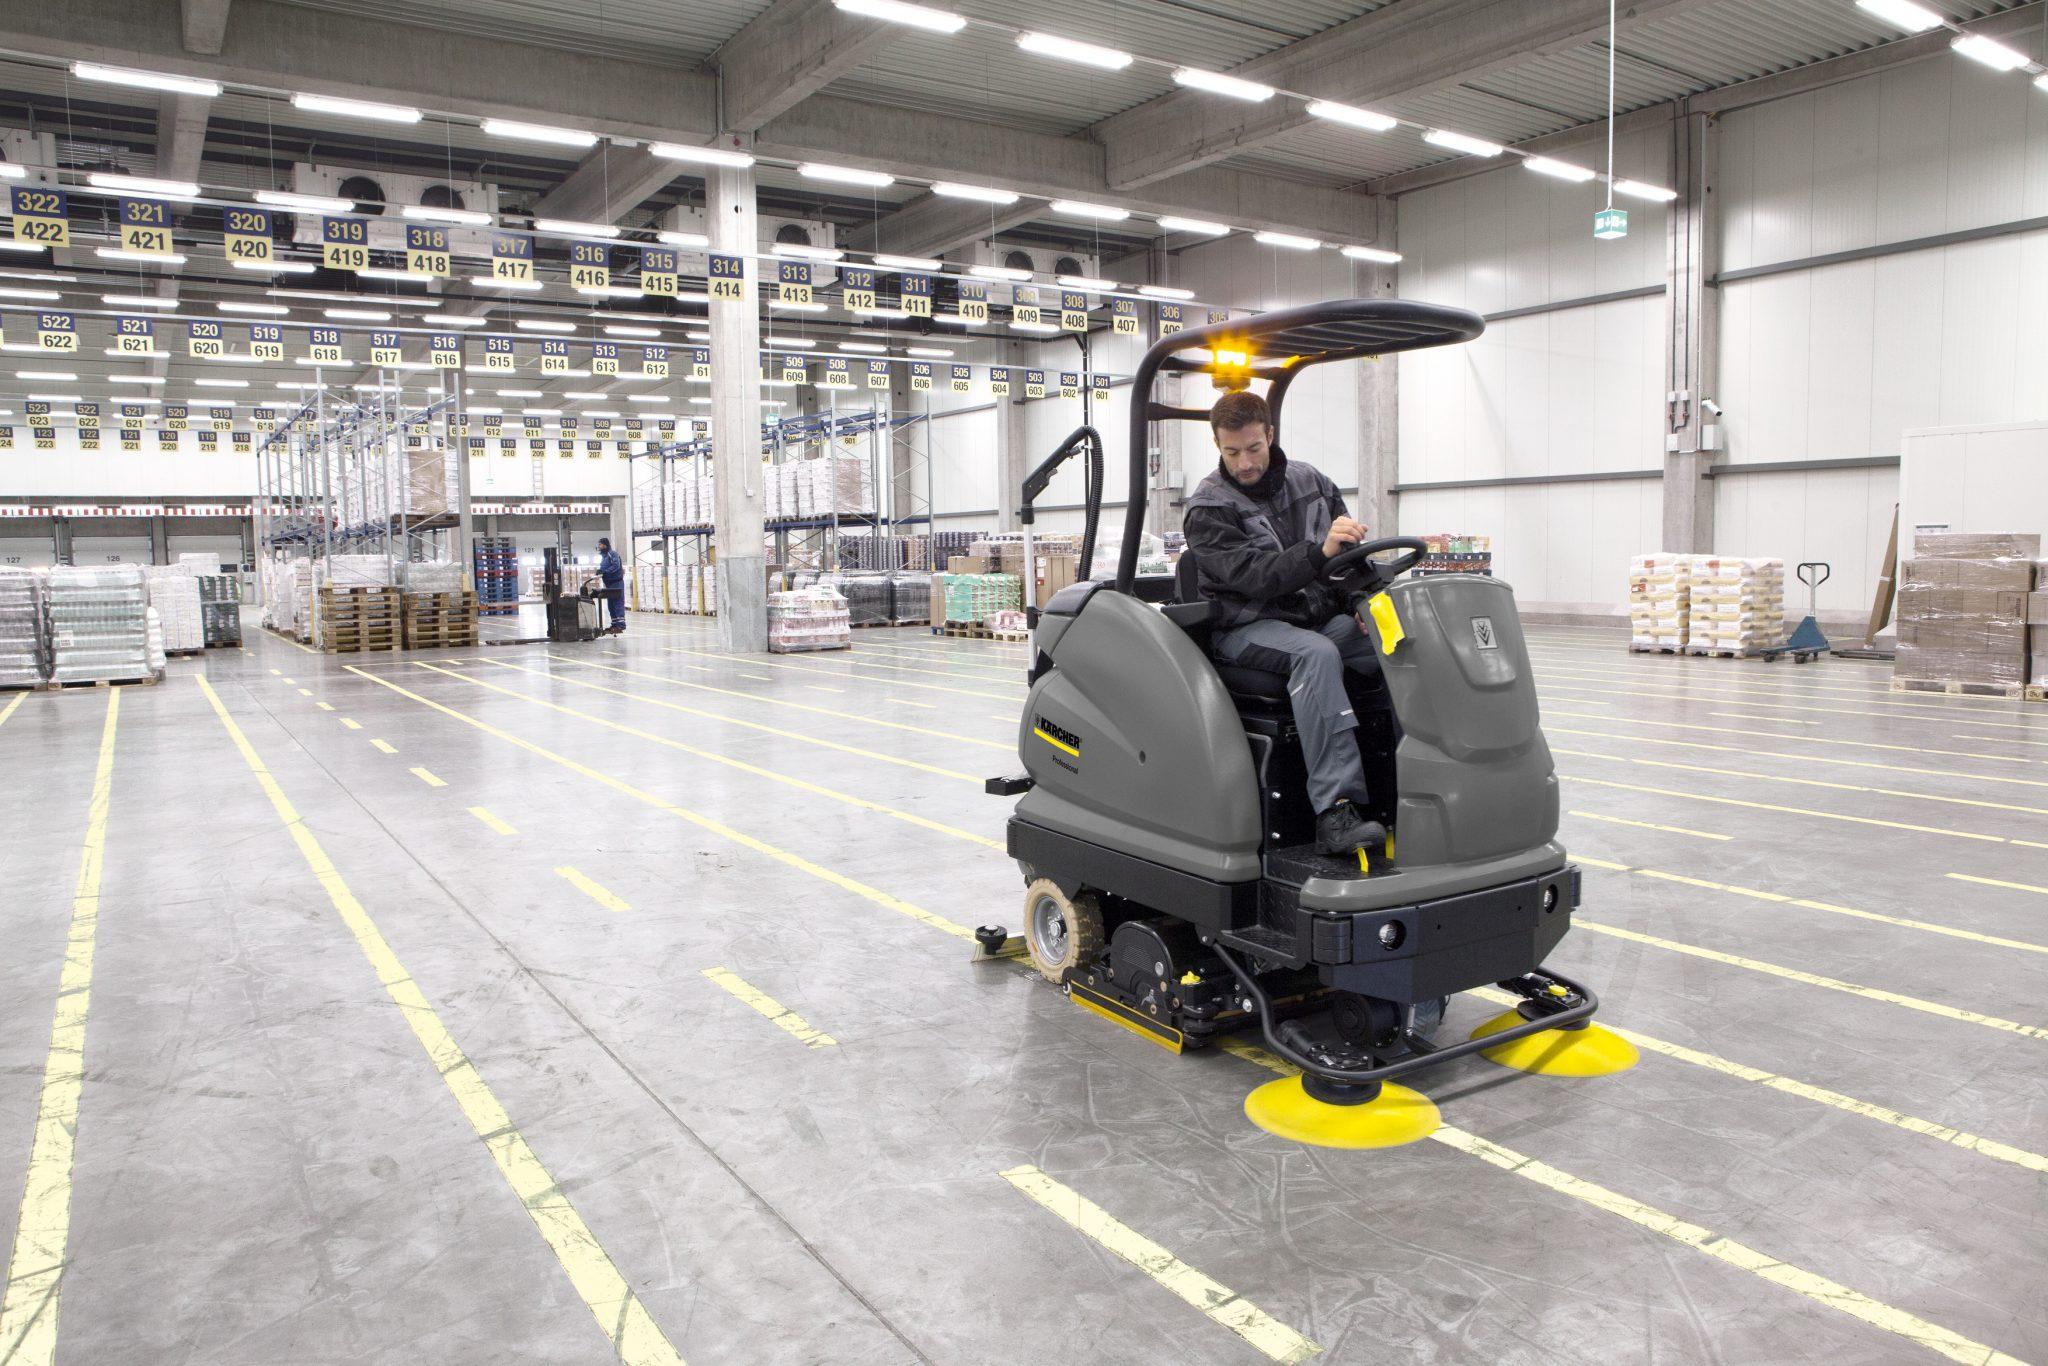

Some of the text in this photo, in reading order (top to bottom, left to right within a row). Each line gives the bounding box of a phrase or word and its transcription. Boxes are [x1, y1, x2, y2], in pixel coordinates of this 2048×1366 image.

[18, 191, 61, 214] 322
[127, 202, 164, 223] 321
[229, 212, 266, 232] 320
[21, 221, 64, 242] 422
[327, 221, 363, 241] 319
[128, 231, 165, 250] 421
[411, 229, 444, 248] 318
[231, 239, 268, 258] 420
[575, 246, 605, 263] 316
[330, 248, 364, 266] 419
[645, 252, 674, 269] 315
[414, 255, 446, 273] 418
[497, 262, 528, 278] 417
[713, 258, 740, 274] 314
[575, 270, 605, 286] 416
[782, 265, 808, 281] 313
[645, 276, 673, 293] 415
[847, 272, 871, 287] 312
[905, 277, 927, 293] 311
[714, 282, 741, 298] 414
[783, 287, 809, 303] 413
[848, 292, 872, 308] 412
[905, 298, 927, 314] 411
[1064, 294, 1084, 309] 308
[962, 303, 984, 318] 410
[1115, 300, 1134, 313] 307
[1162, 305, 1180, 319] 306
[42, 315, 71, 329] 522
[1017, 309, 1037, 323] 409
[1065, 314, 1085, 328] 408
[122, 319, 148, 333] 521
[192, 323, 218, 337] 520
[1117, 319, 1135, 332] 407
[254, 327, 279, 340] 519
[313, 330, 338, 344] 518
[374, 333, 397, 346] 517
[44, 335, 72, 348] 622
[123, 338, 148, 352] 621
[433, 336, 456, 349] 516
[488, 338, 510, 351] 515
[544, 341, 565, 354] 514
[193, 342, 219, 355] 620
[254, 345, 279, 358] 619
[314, 348, 338, 361] 618
[595, 345, 616, 357] 513
[646, 348, 665, 360] 512
[374, 350, 398, 363] 617
[435, 353, 457, 365] 616
[489, 355, 510, 368] 615
[786, 357, 804, 367] 509
[544, 358, 565, 370] 614
[596, 360, 616, 373] 613
[646, 363, 665, 375] 612
[829, 359, 846, 370] 508
[870, 362, 887, 372] 507
[914, 364, 930, 374] 506
[786, 371, 804, 382] 609
[954, 367, 969, 377] 505
[992, 370, 1007, 380] 504
[1028, 372, 1043, 382] 503
[829, 374, 846, 384] 608
[870, 377, 887, 386] 607
[914, 379, 930, 389] 606
[1062, 375, 1076, 385] 502
[1096, 377, 1108, 387] 501
[954, 381, 969, 391] 605
[992, 384, 1007, 393] 604
[1028, 386, 1043, 396] 603
[1062, 388, 1076, 398] 602
[1096, 391, 1108, 400] 601
[28, 404, 48, 413] 523
[78, 405, 97, 415] 522
[125, 407, 142, 416] 521
[168, 408, 185, 417] 520
[212, 409, 230, 418] 519
[256, 410, 273, 418] 518
[29, 416, 49, 426] 623
[79, 418, 97, 427] 622
[125, 418, 143, 428] 621
[169, 420, 186, 429] 620
[214, 421, 231, 430] 619
[486, 417, 500, 425] 512
[526, 418, 538, 426] 511
[596, 420, 609, 428] 509
[37, 429, 53, 437] 123
[82, 430, 97, 438] 122
[123, 431, 138, 439] 121
[161, 432, 175, 440] 120
[201, 433, 215, 441] 119
[234, 434, 249, 442] 118
[37, 440, 54, 448] 223
[82, 441, 98, 449] 222
[124, 442, 139, 450] 221
[162, 443, 176, 451] 220
[201, 443, 216, 451] 219
[235, 444, 250, 452] 218
